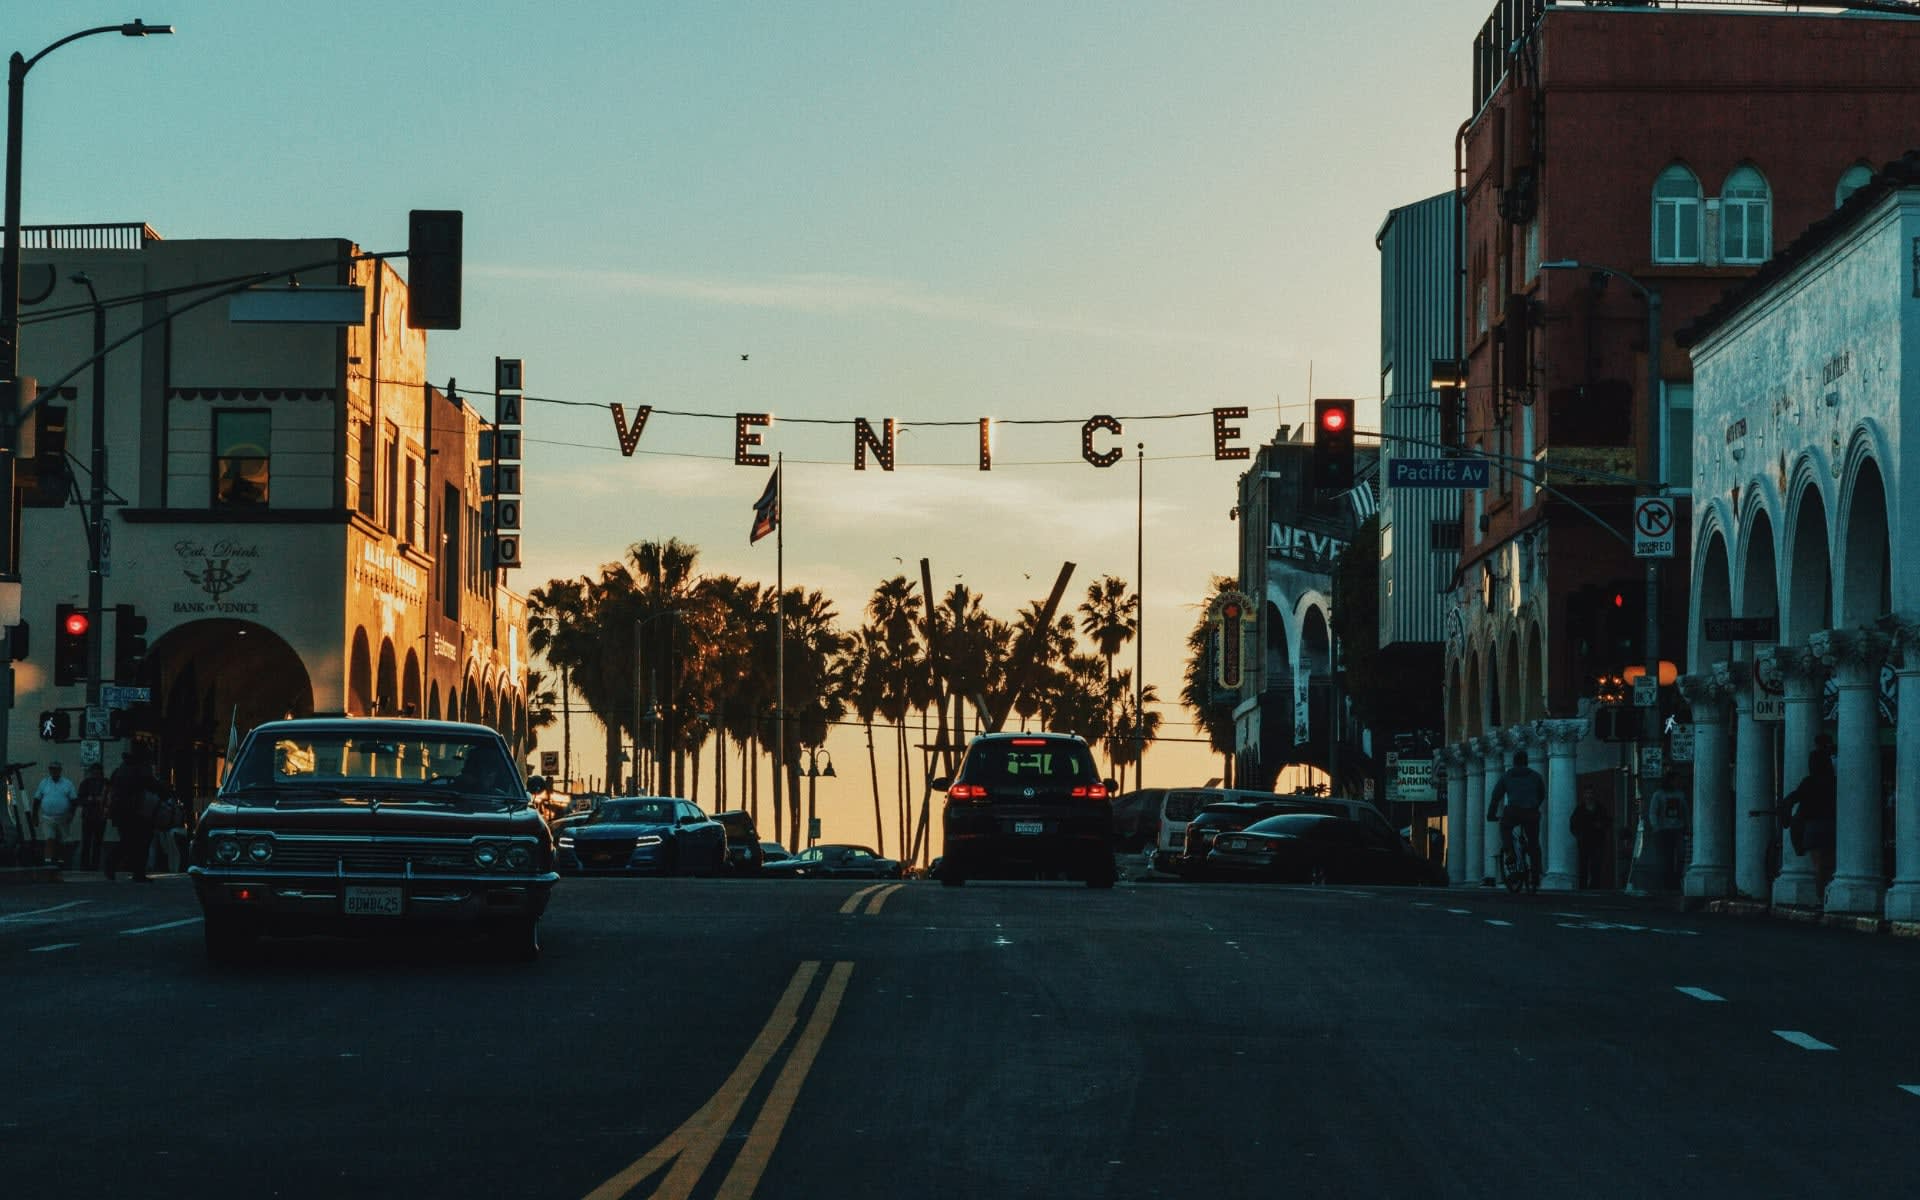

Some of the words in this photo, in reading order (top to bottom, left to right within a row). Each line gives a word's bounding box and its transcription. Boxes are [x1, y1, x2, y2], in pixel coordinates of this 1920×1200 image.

[610, 402, 1250, 472] VENICE
[501, 362, 517, 560] TATTOO
[1397, 464, 1456, 481] Pacific
[1462, 464, 1482, 481] Av
[174, 602, 205, 613] BANK
[217, 602, 258, 613] VENICE
[1757, 702, 1774, 713] ON
